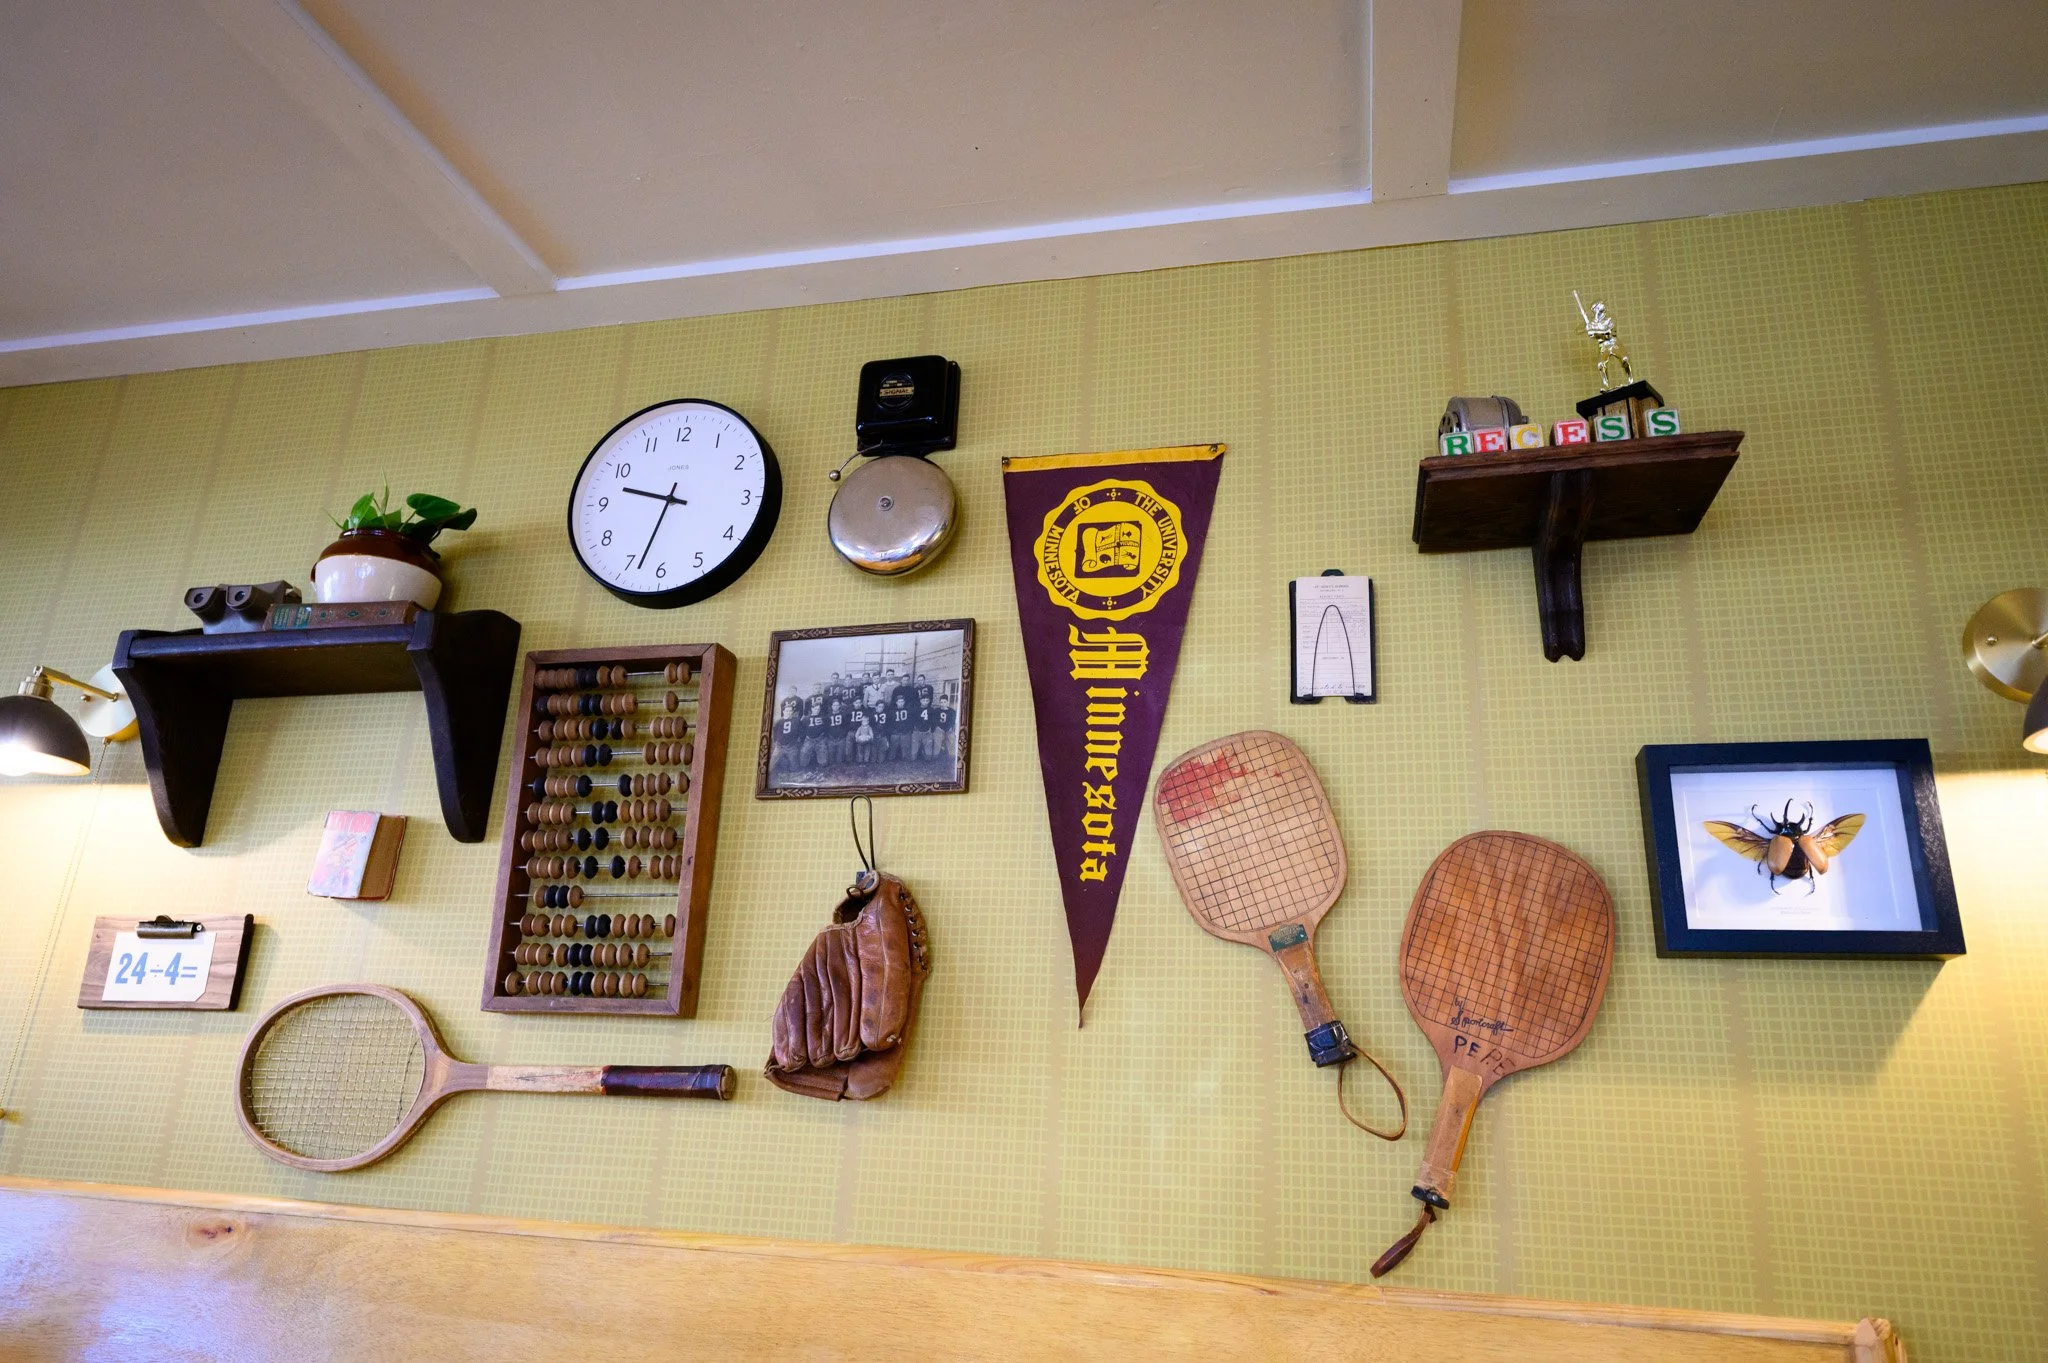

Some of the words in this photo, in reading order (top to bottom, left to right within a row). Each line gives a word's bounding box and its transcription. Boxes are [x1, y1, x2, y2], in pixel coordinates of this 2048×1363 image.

[676, 427, 692, 443] 12
[715, 433, 721, 449] 1
[1445, 411, 1677, 456] RECESS
[645, 437, 658, 453] 11
[615, 462, 631, 479] 10
[734, 454, 745, 471] 2
[598, 496, 609, 512] 9
[740, 489, 751, 505] 3
[1134, 491, 1163, 516] THE
[1072, 497, 1092, 515] OF
[601, 529, 613, 546] 8
[723, 525, 734, 541] 4
[624, 554, 636, 571] 7
[692, 552, 704, 568] 5
[1044, 524, 1082, 604] MINNESOTA
[1141, 516, 1178, 600] UNIVERSITY
[655, 562, 667, 579] 6
[830, 714, 842, 726] 19
[850, 711, 864, 722] 12
[894, 709, 908, 722] 10
[920, 709, 929, 721] 4
[939, 712, 947, 723] 9
[782, 721, 792, 735] 9
[1068, 623, 1151, 882] Minnesota
